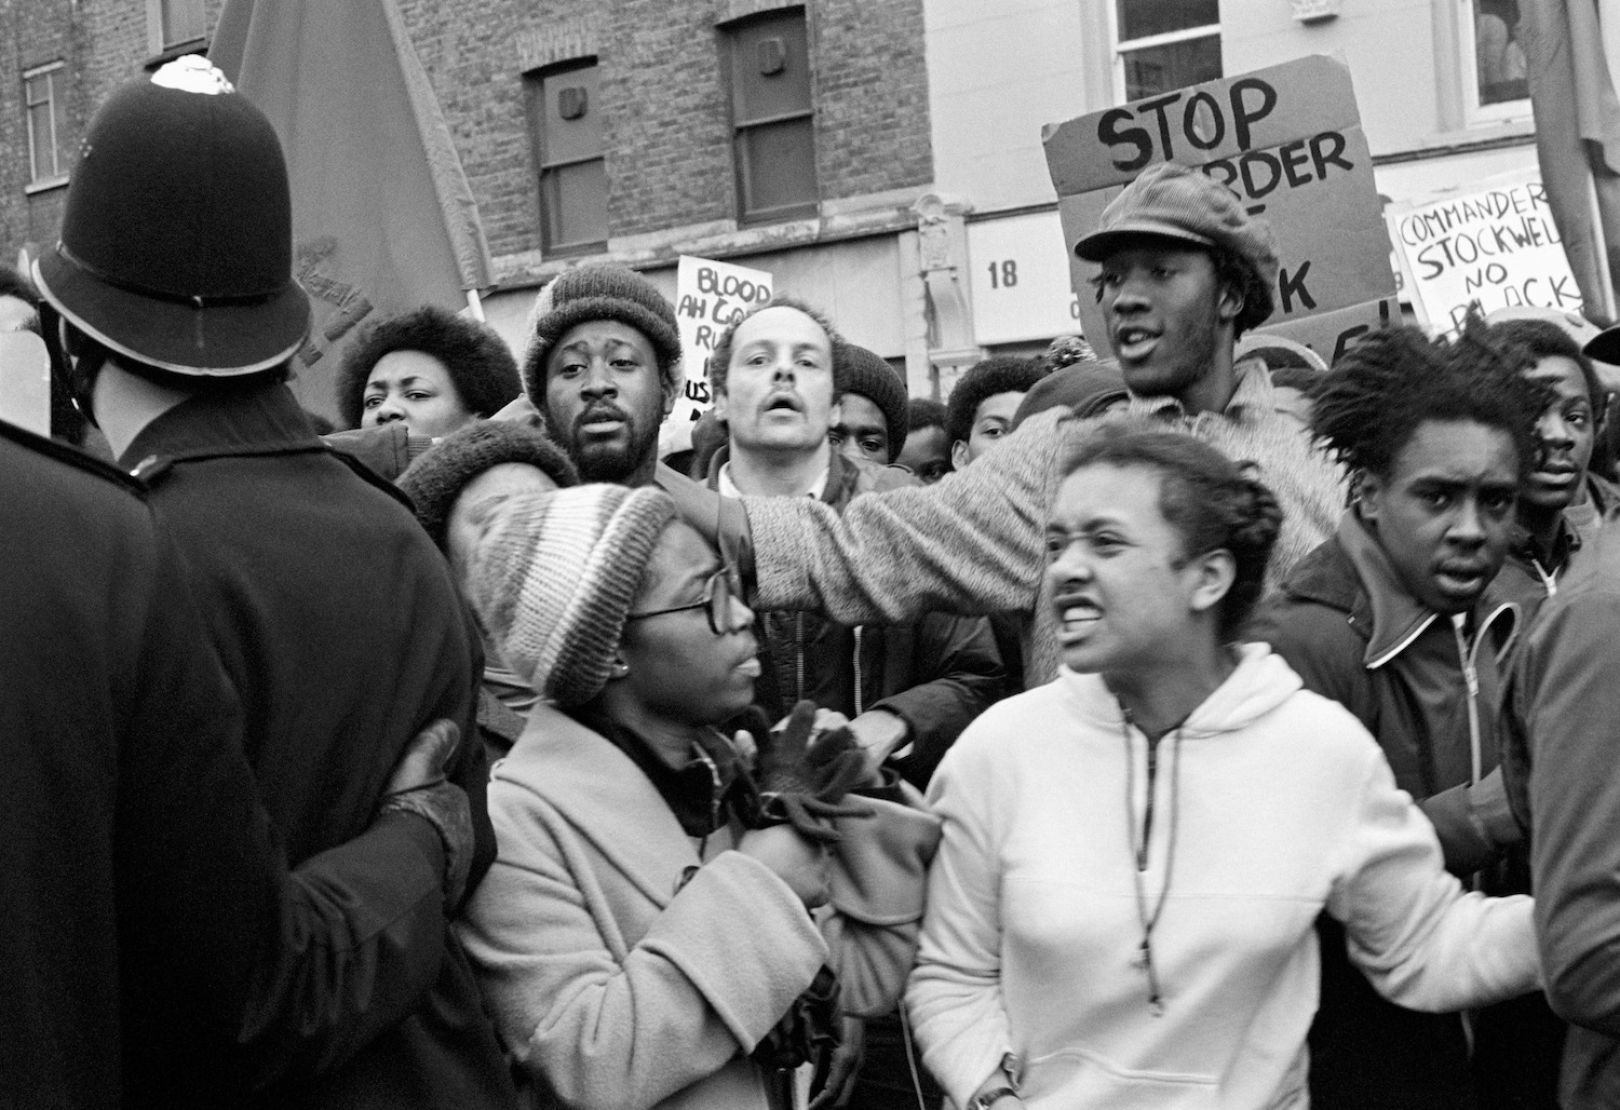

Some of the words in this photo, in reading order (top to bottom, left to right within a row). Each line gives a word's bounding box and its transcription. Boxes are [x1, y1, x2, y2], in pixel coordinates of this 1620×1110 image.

[1097, 78, 1278, 171] STOP
[1202, 130, 1354, 201] RDER
[1400, 183, 1549, 246] COMMANDER
[1417, 215, 1563, 281] STOCKWEL
[698, 267, 772, 305] BLOOD
[988, 260, 1018, 289] 18
[1465, 263, 1508, 294] NO
[678, 294, 706, 319] AH
[695, 325, 723, 351] RU
